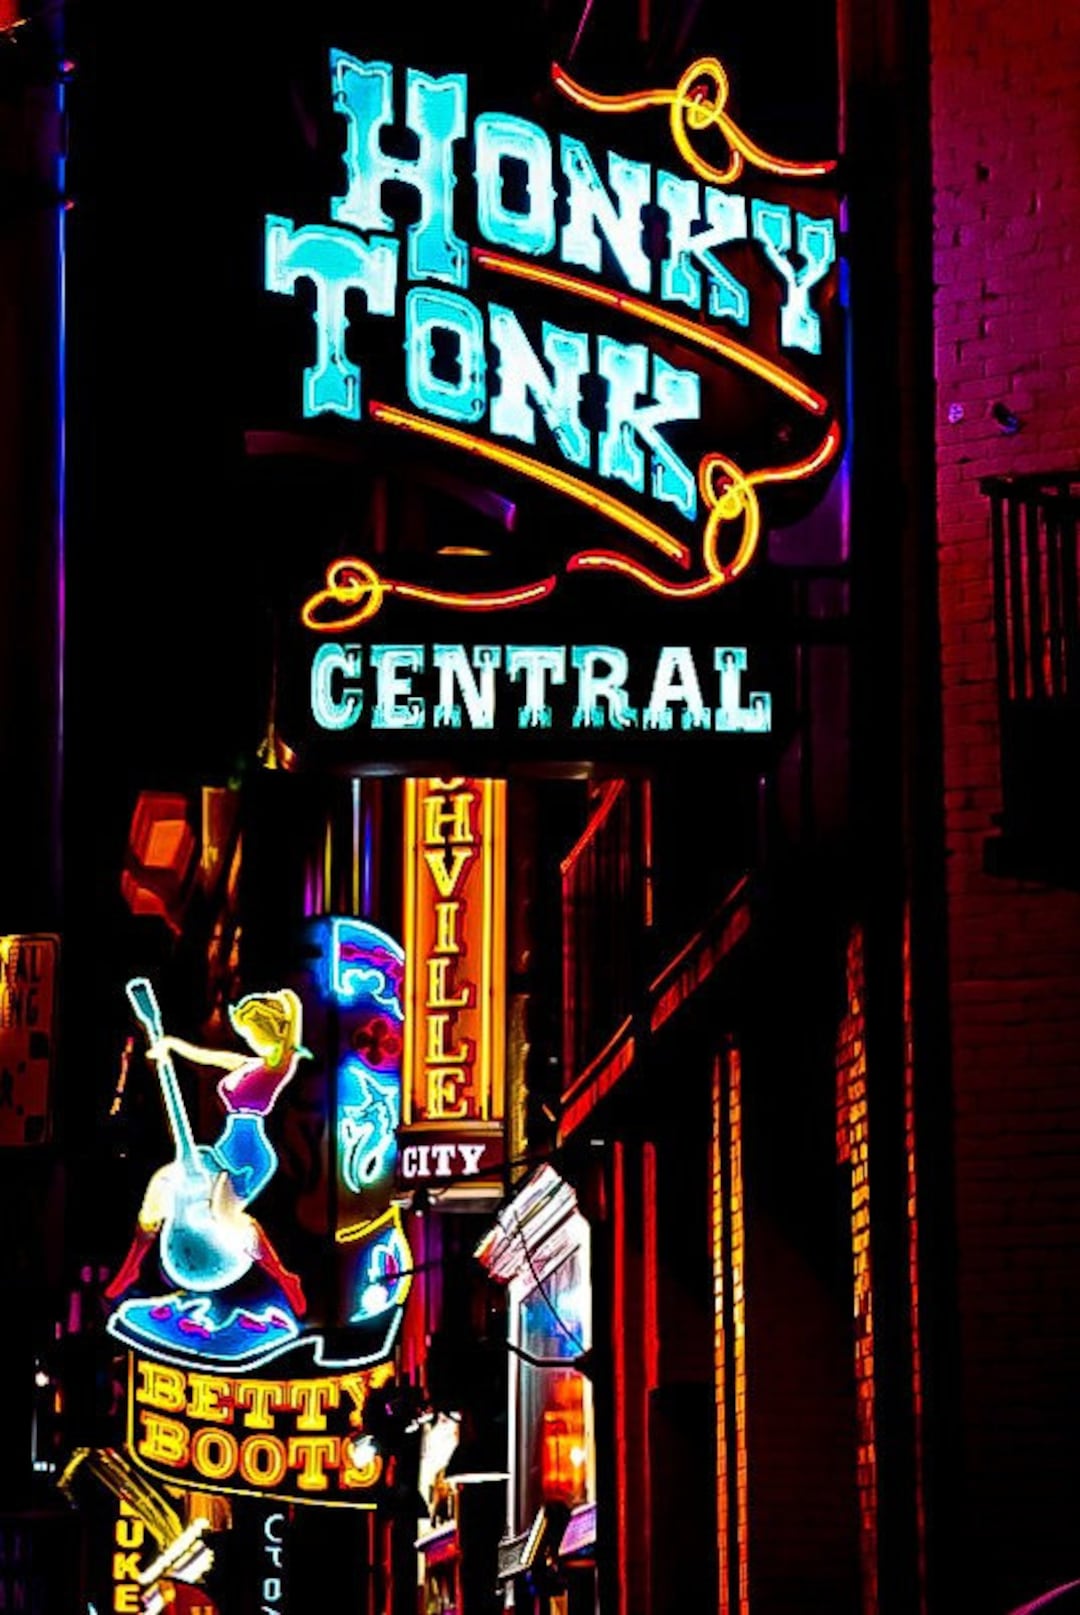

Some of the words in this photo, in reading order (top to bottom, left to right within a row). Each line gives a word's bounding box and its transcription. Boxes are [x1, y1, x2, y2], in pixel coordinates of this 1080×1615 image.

[328, 47, 836, 356] HONKY
[264, 213, 702, 520] TONK
[310, 642, 772, 734] CENTRAL
[402, 1144, 486, 1178] CITY
[135, 1360, 396, 1433] BETTY
[138, 1410, 384, 1492] BOOTS
